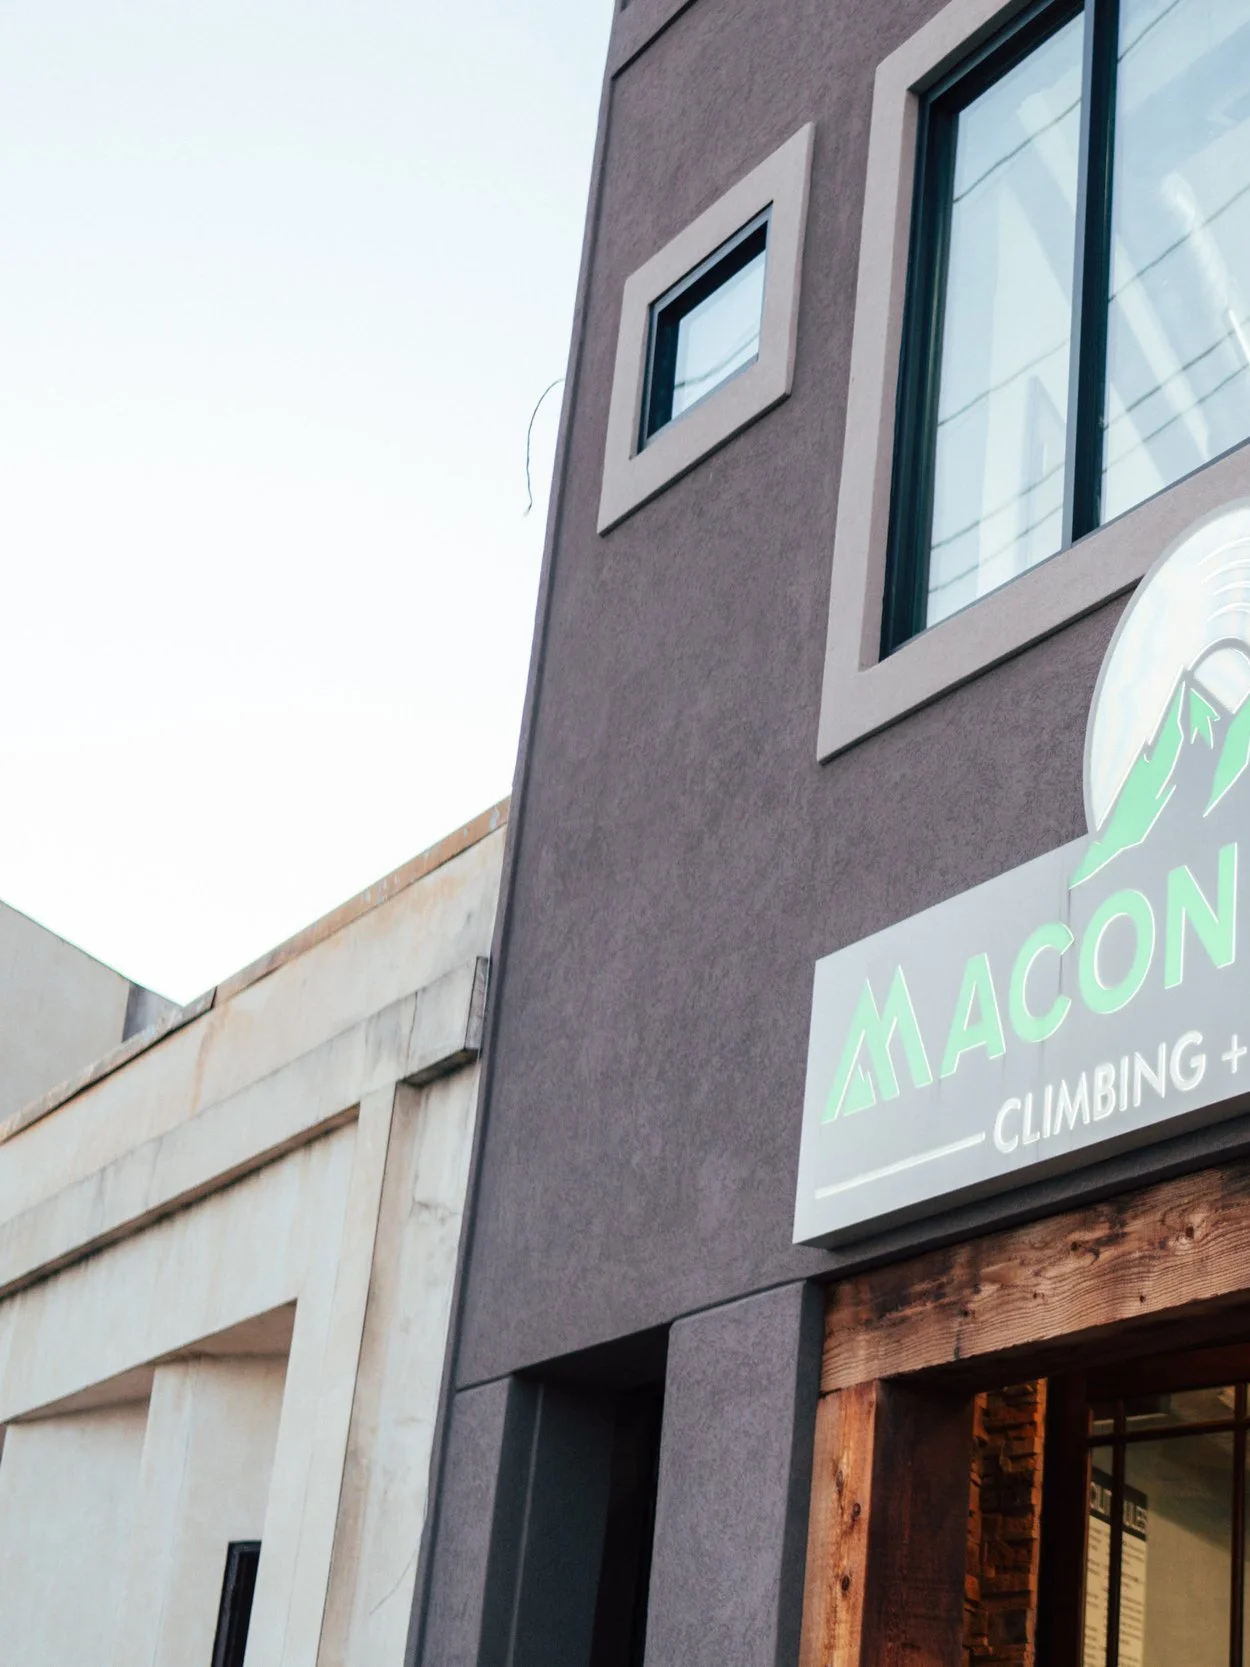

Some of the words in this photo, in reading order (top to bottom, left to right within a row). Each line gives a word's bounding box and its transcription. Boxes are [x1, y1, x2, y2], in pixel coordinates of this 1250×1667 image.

[821, 842, 1238, 1126] MACON
[993, 1030, 1207, 1154] CLIMBING
[1221, 1034, 1247, 1074] +
